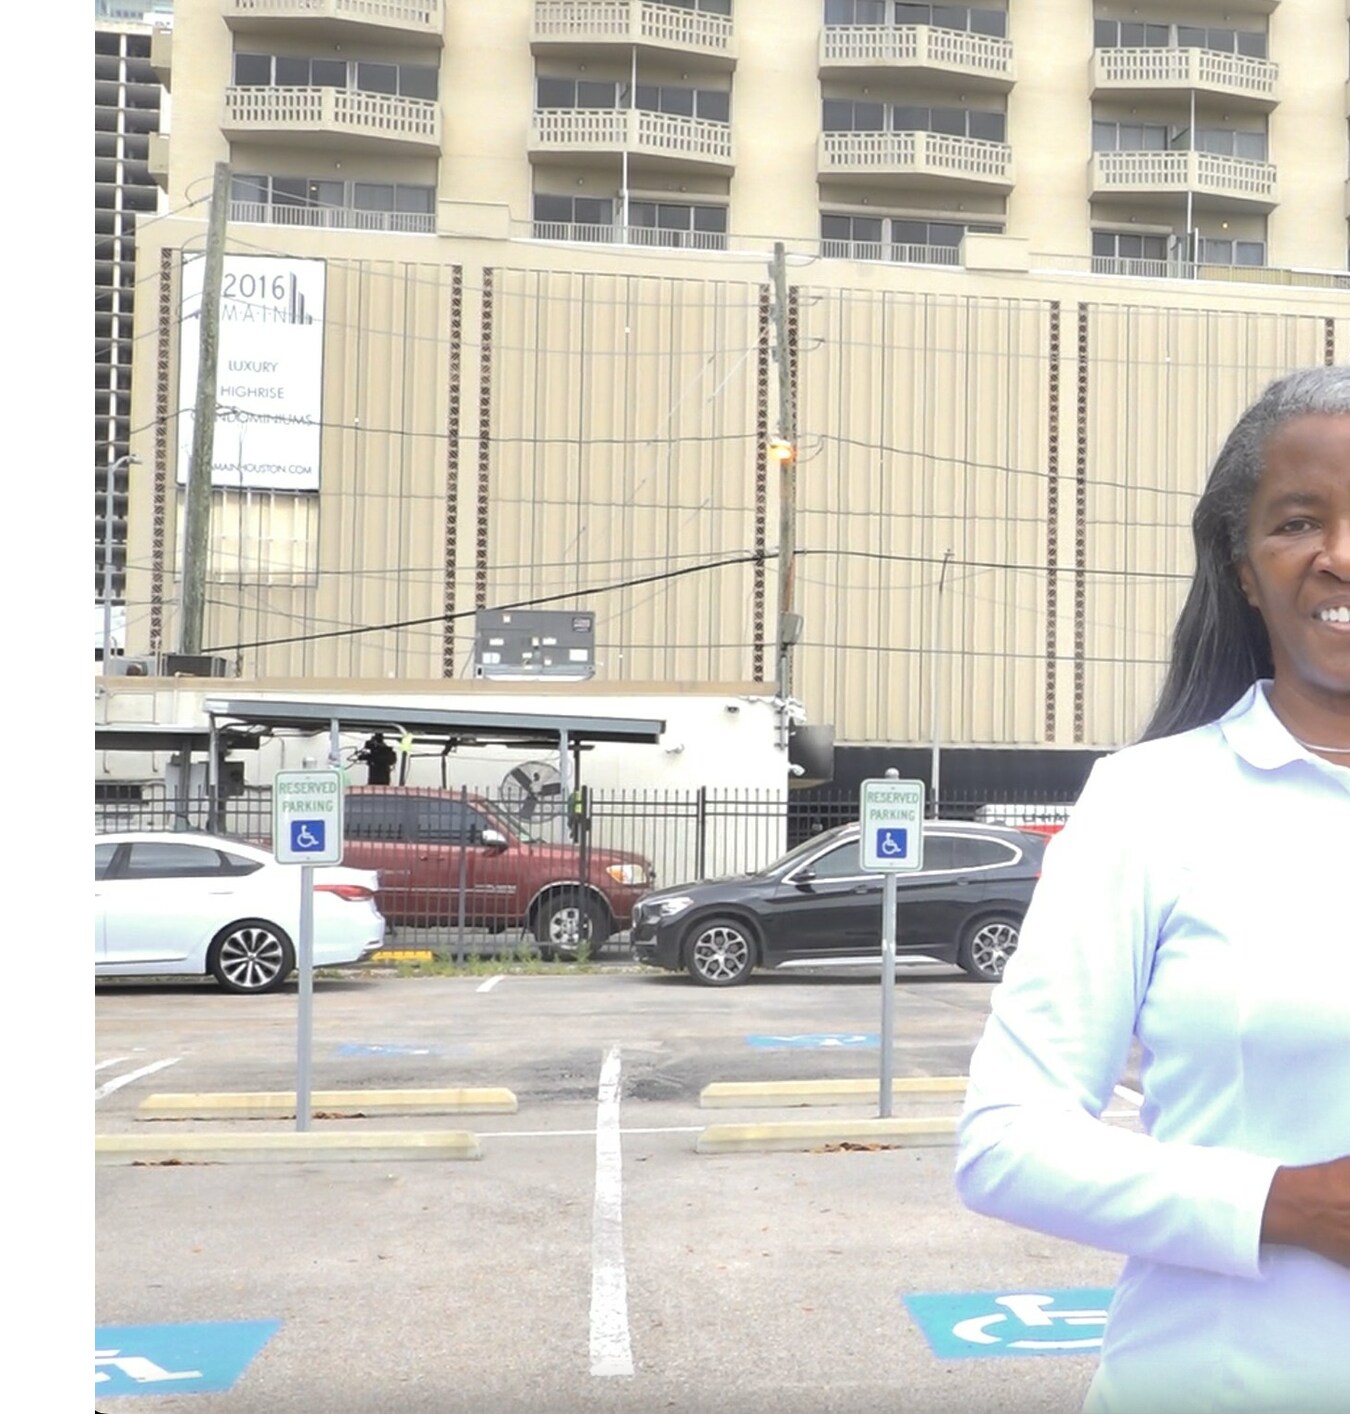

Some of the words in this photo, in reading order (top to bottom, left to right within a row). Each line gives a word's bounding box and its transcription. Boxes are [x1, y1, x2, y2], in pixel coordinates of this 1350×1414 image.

[222, 272, 286, 300] 2016
[228, 359, 279, 373] LUXURY
[220, 385, 285, 399] HIGHRISE
[278, 781, 337, 794] RESERVED
[867, 791, 919, 804] RESERVED
[282, 800, 333, 812] PARKING
[869, 809, 915, 821] PARKING
